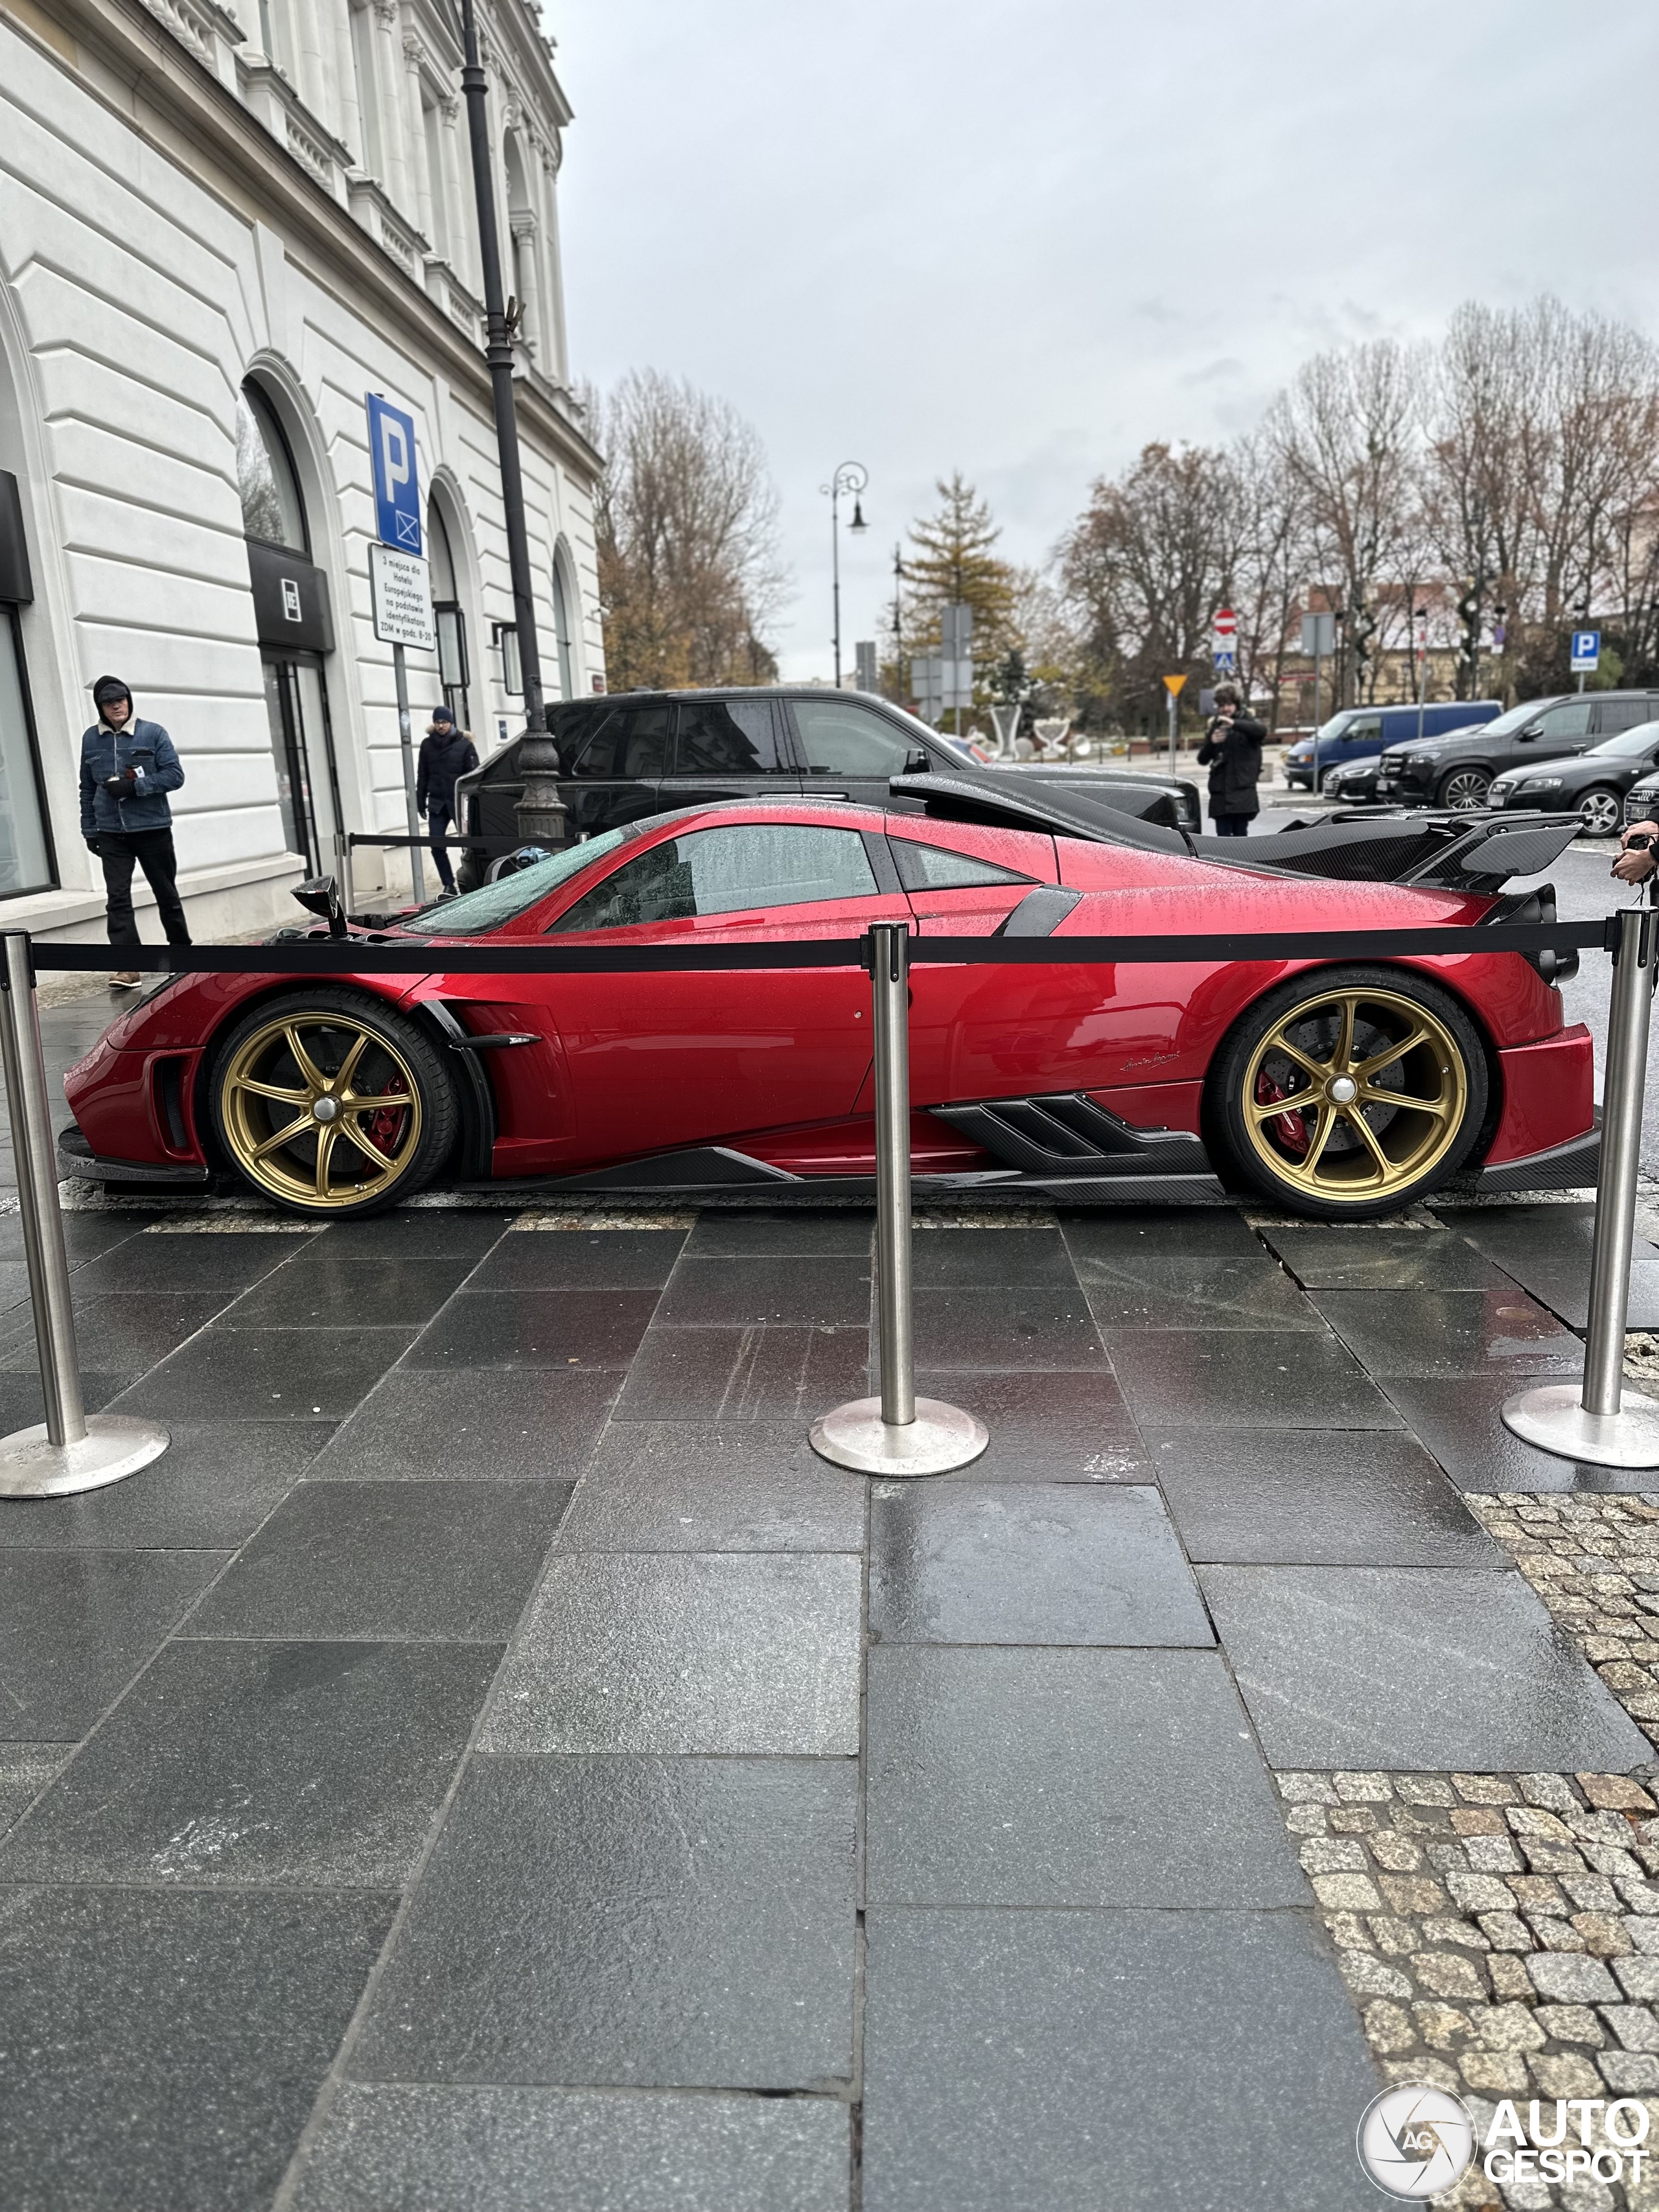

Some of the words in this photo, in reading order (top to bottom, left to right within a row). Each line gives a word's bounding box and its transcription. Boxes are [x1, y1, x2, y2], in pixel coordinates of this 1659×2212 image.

[380, 413, 409, 504] P
[382, 555, 387, 565] 3
[389, 559, 410, 572] miejsca
[412, 565, 421, 575] dla
[393, 572, 413, 585] Hotelu
[384, 583, 423, 603] Europejskiego
[395, 601, 424, 614] podstawie
[386, 609, 426, 627] identyfikatora
[380, 622, 394, 633] ZDM
[402, 629, 417, 638] godz.
[419, 630, 432, 641] 8-20
[1577, 634, 1594, 655] P
